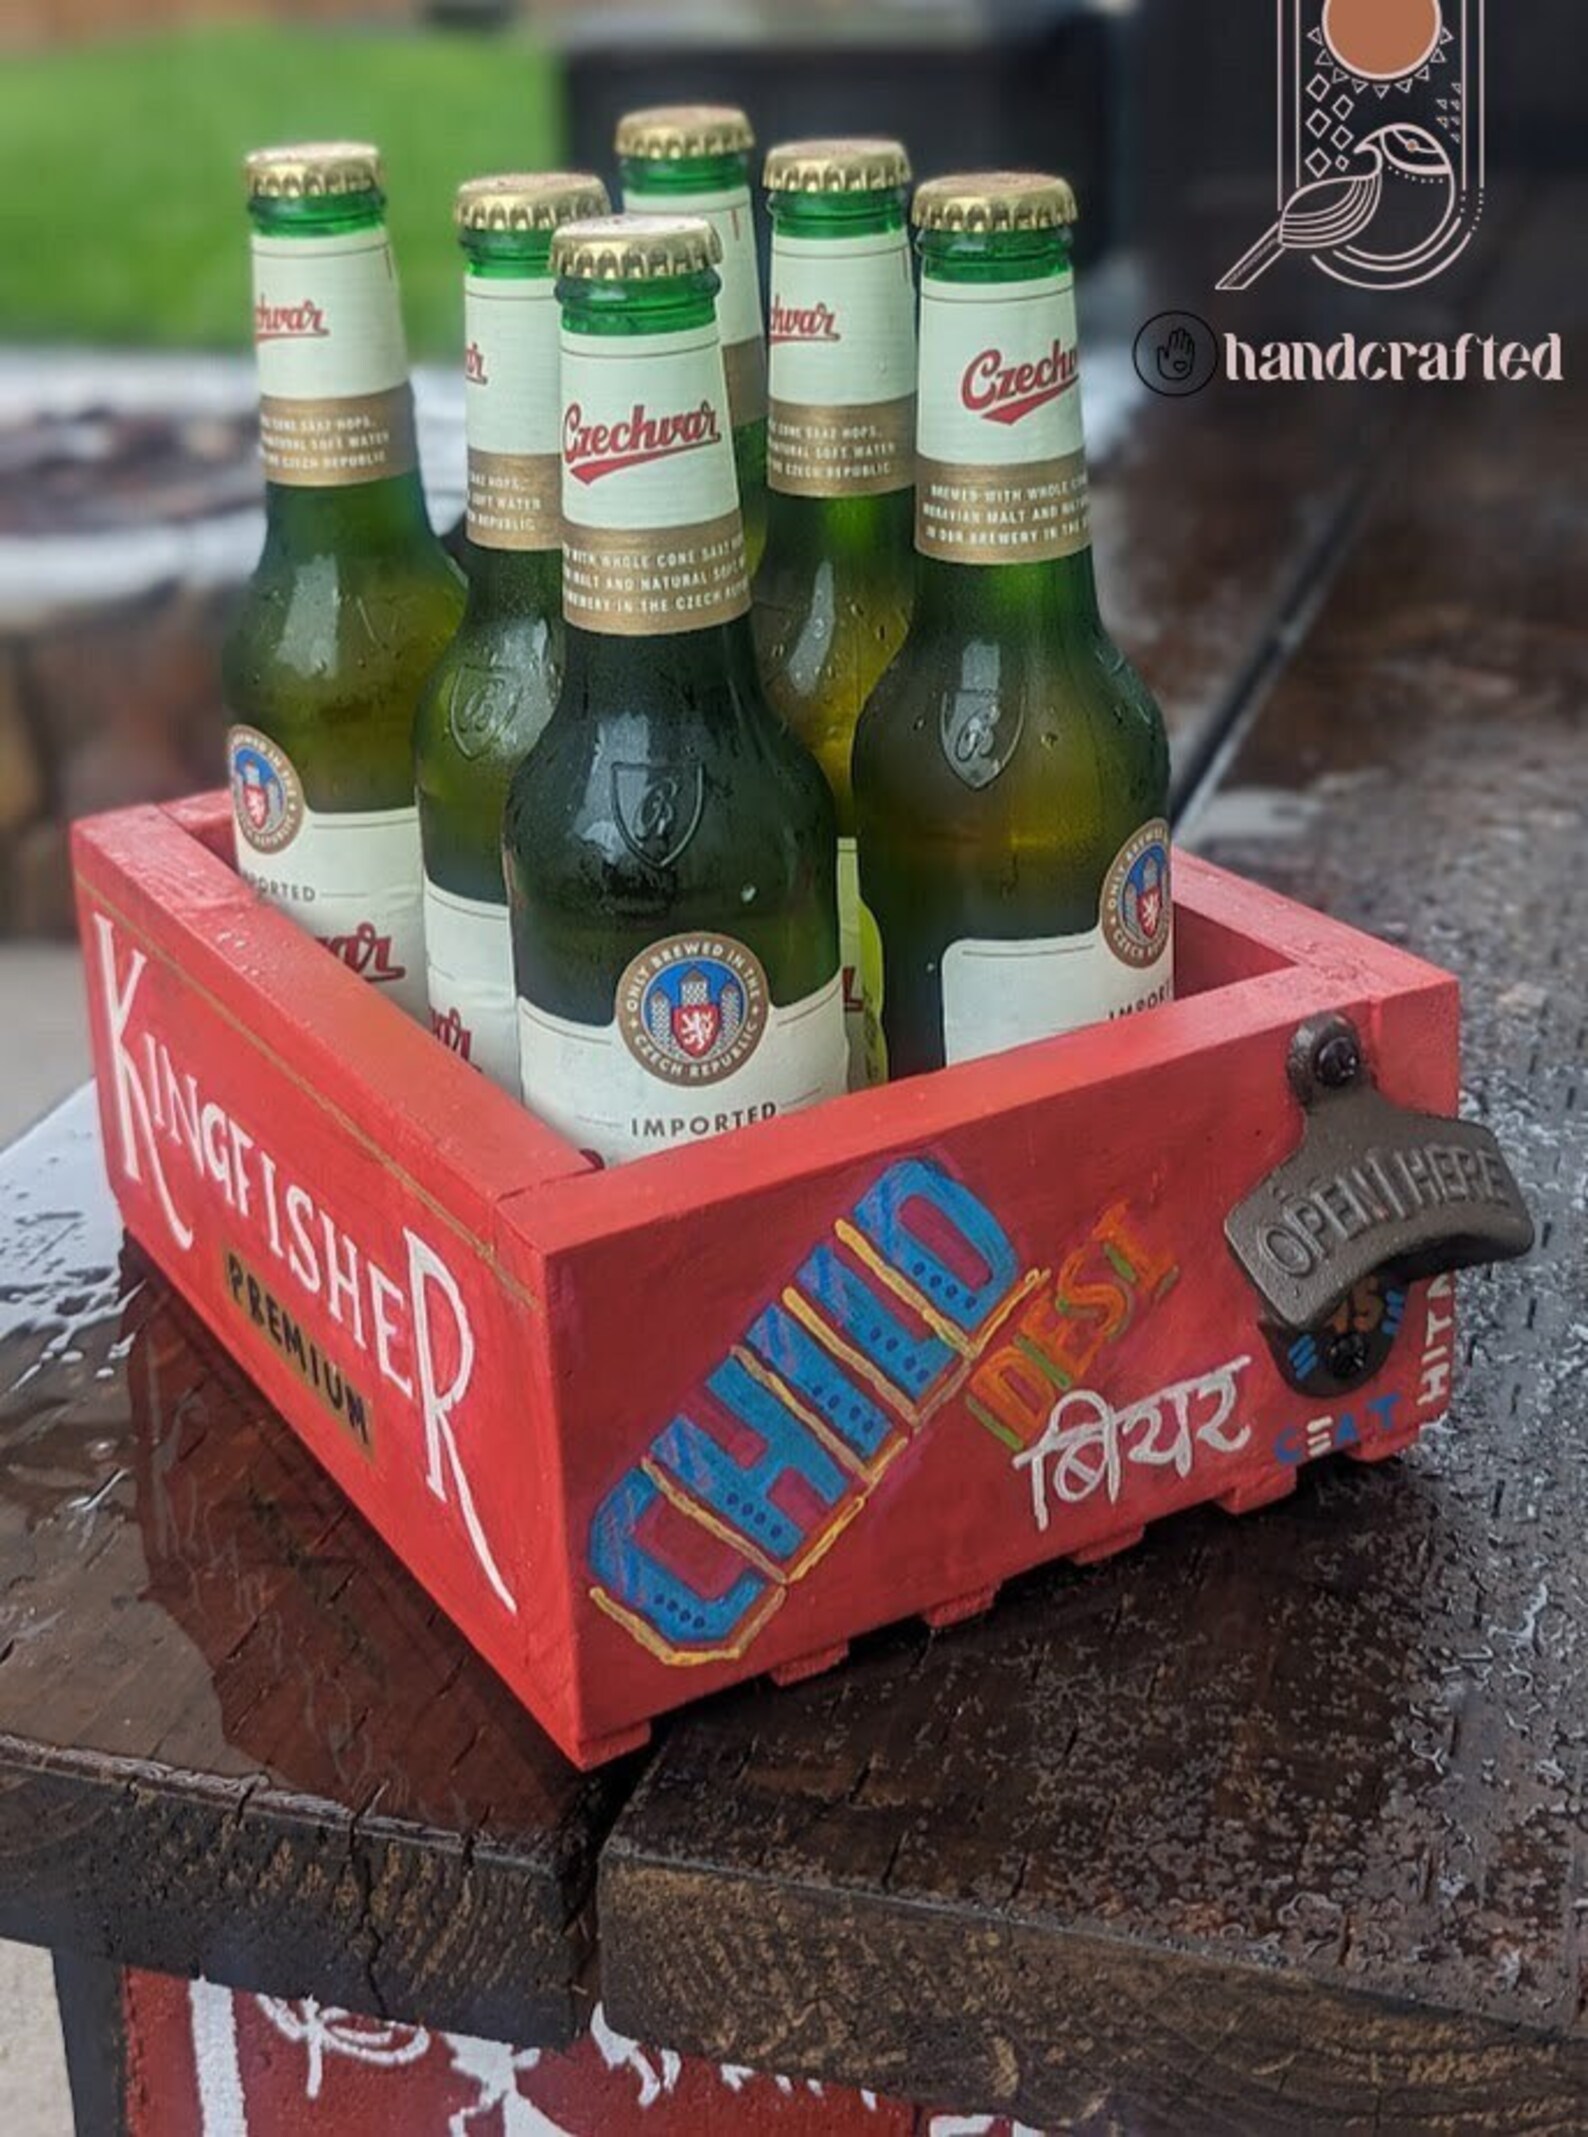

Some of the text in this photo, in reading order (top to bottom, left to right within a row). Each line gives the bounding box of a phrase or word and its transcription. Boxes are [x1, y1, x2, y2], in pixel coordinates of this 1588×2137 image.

[563, 399, 722, 470] Czechvar
[650, 941, 724, 969] BREWED
[727, 950, 747, 969] IN
[688, 1020, 758, 1078] REPUBLIC
[632, 1101, 777, 1138] IMPORTED
[92, 910, 518, 1616] KINGFISHER
[1256, 1146, 1511, 1278] OPEN HERE
[228, 1252, 370, 1446] PREMIUM
[966, 1200, 1179, 1453] DESI
[587, 1156, 1022, 1646] CHILD
